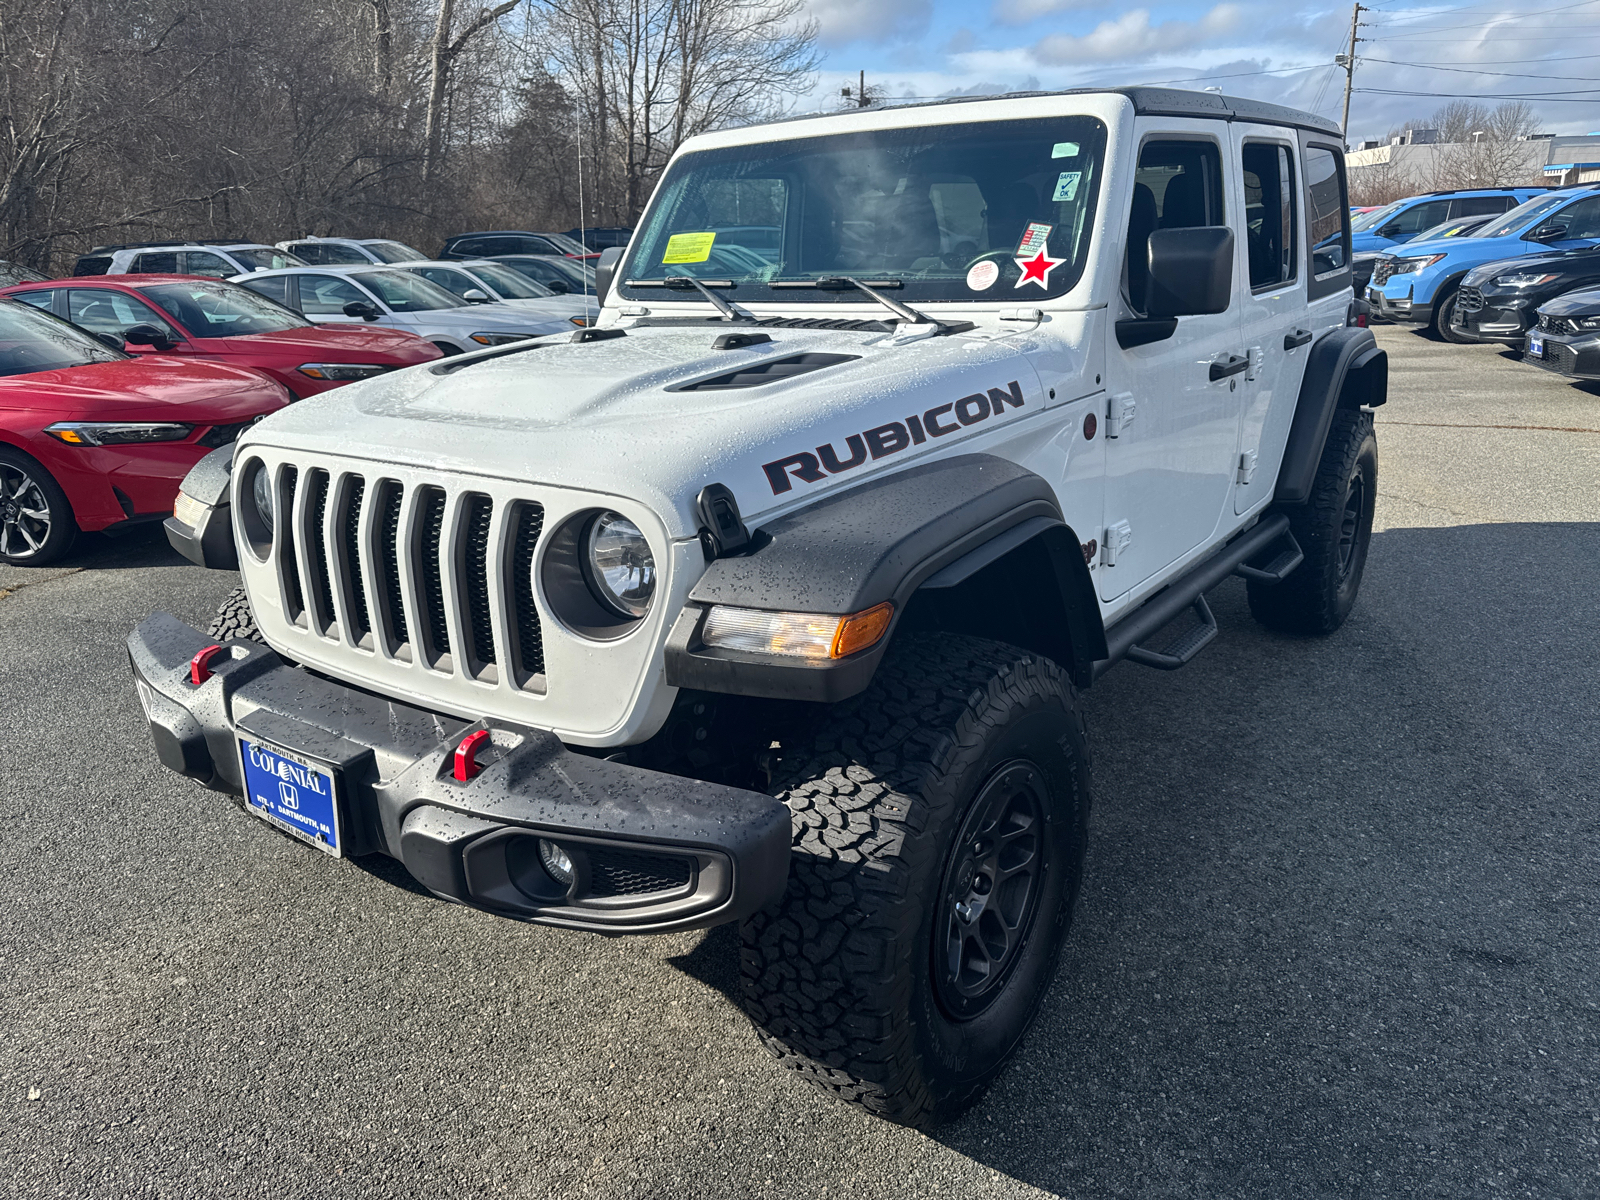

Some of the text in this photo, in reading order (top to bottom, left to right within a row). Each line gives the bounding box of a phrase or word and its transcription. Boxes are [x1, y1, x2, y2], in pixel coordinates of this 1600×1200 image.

[762, 380, 1025, 496] RUBICON
[249, 749, 326, 796] COLONIAL
[278, 804, 319, 831] DARTMOUTH,
[320, 823, 331, 835] MA
